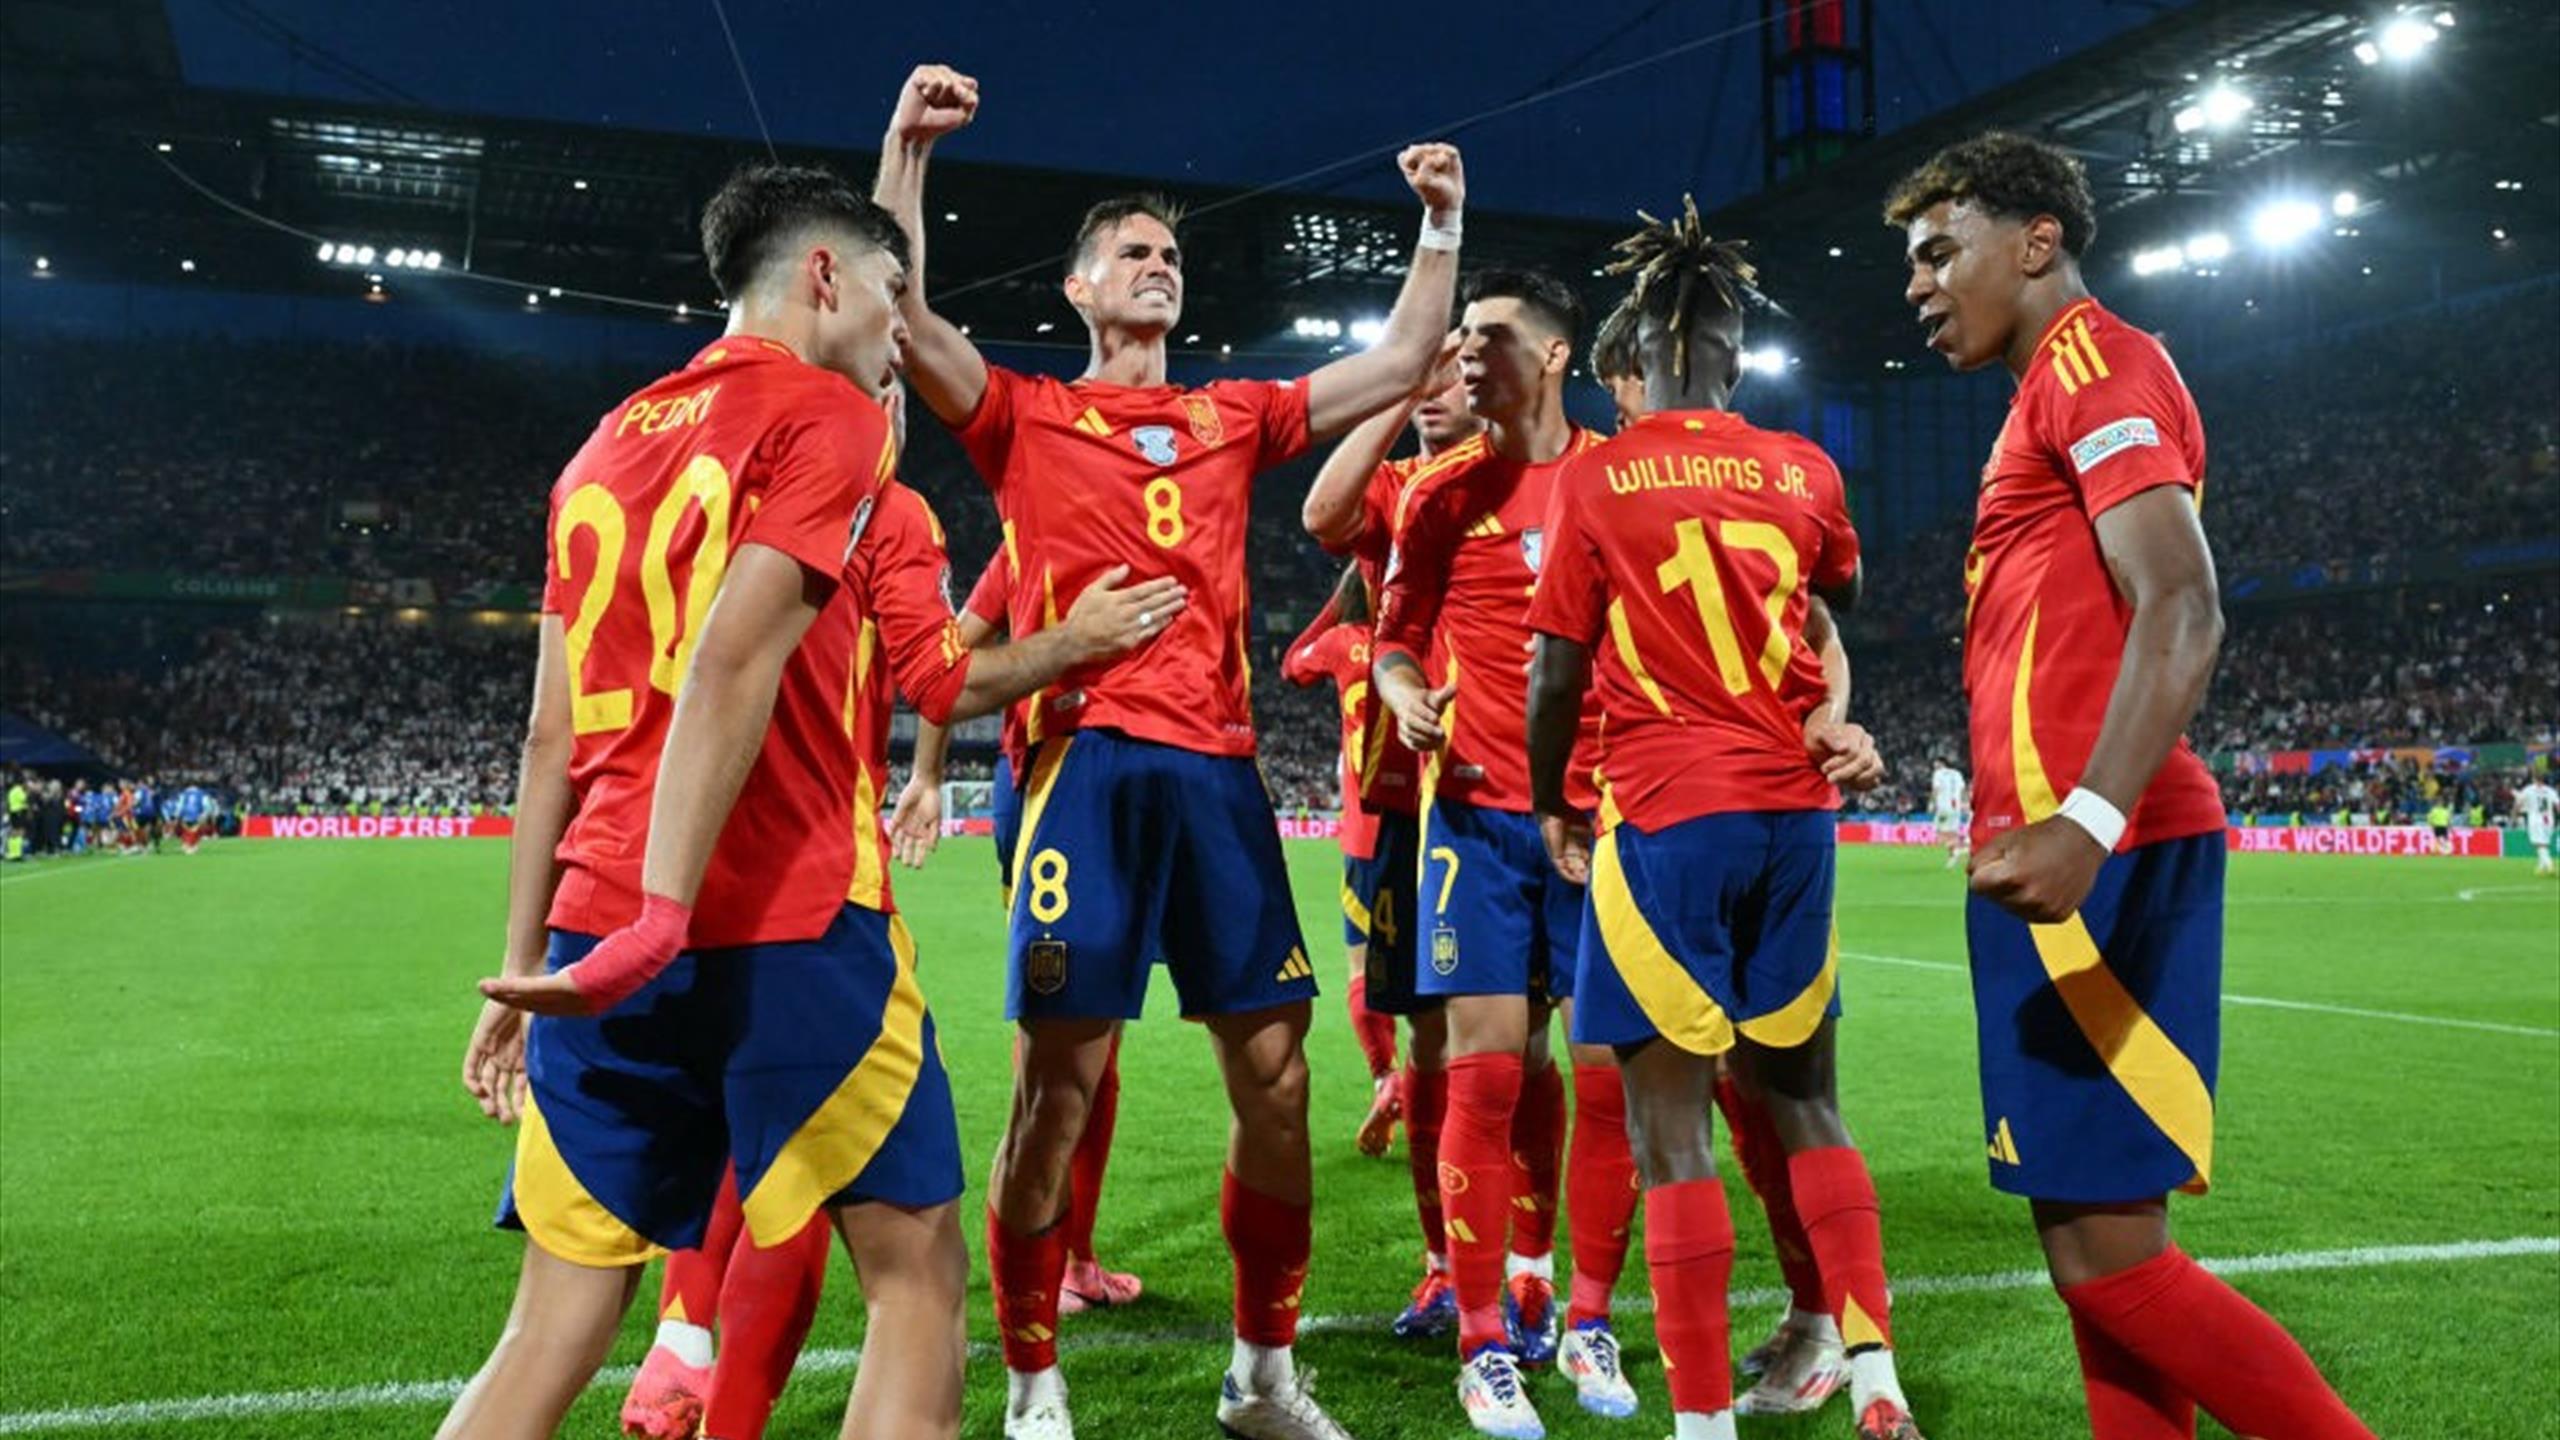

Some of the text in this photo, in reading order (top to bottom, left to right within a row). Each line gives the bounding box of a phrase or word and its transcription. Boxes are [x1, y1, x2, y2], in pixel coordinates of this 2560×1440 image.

[616, 383, 720, 437] PEDRI
[1605, 455, 1813, 501] WILLIAMS JR.
[1144, 478, 1184, 548] 8
[556, 454, 730, 735] 20
[1656, 517, 1798, 696] 17
[272, 817, 473, 837] WORLDFIRST
[1030, 848, 1069, 923] 8
[1431, 847, 1460, 914] 7
